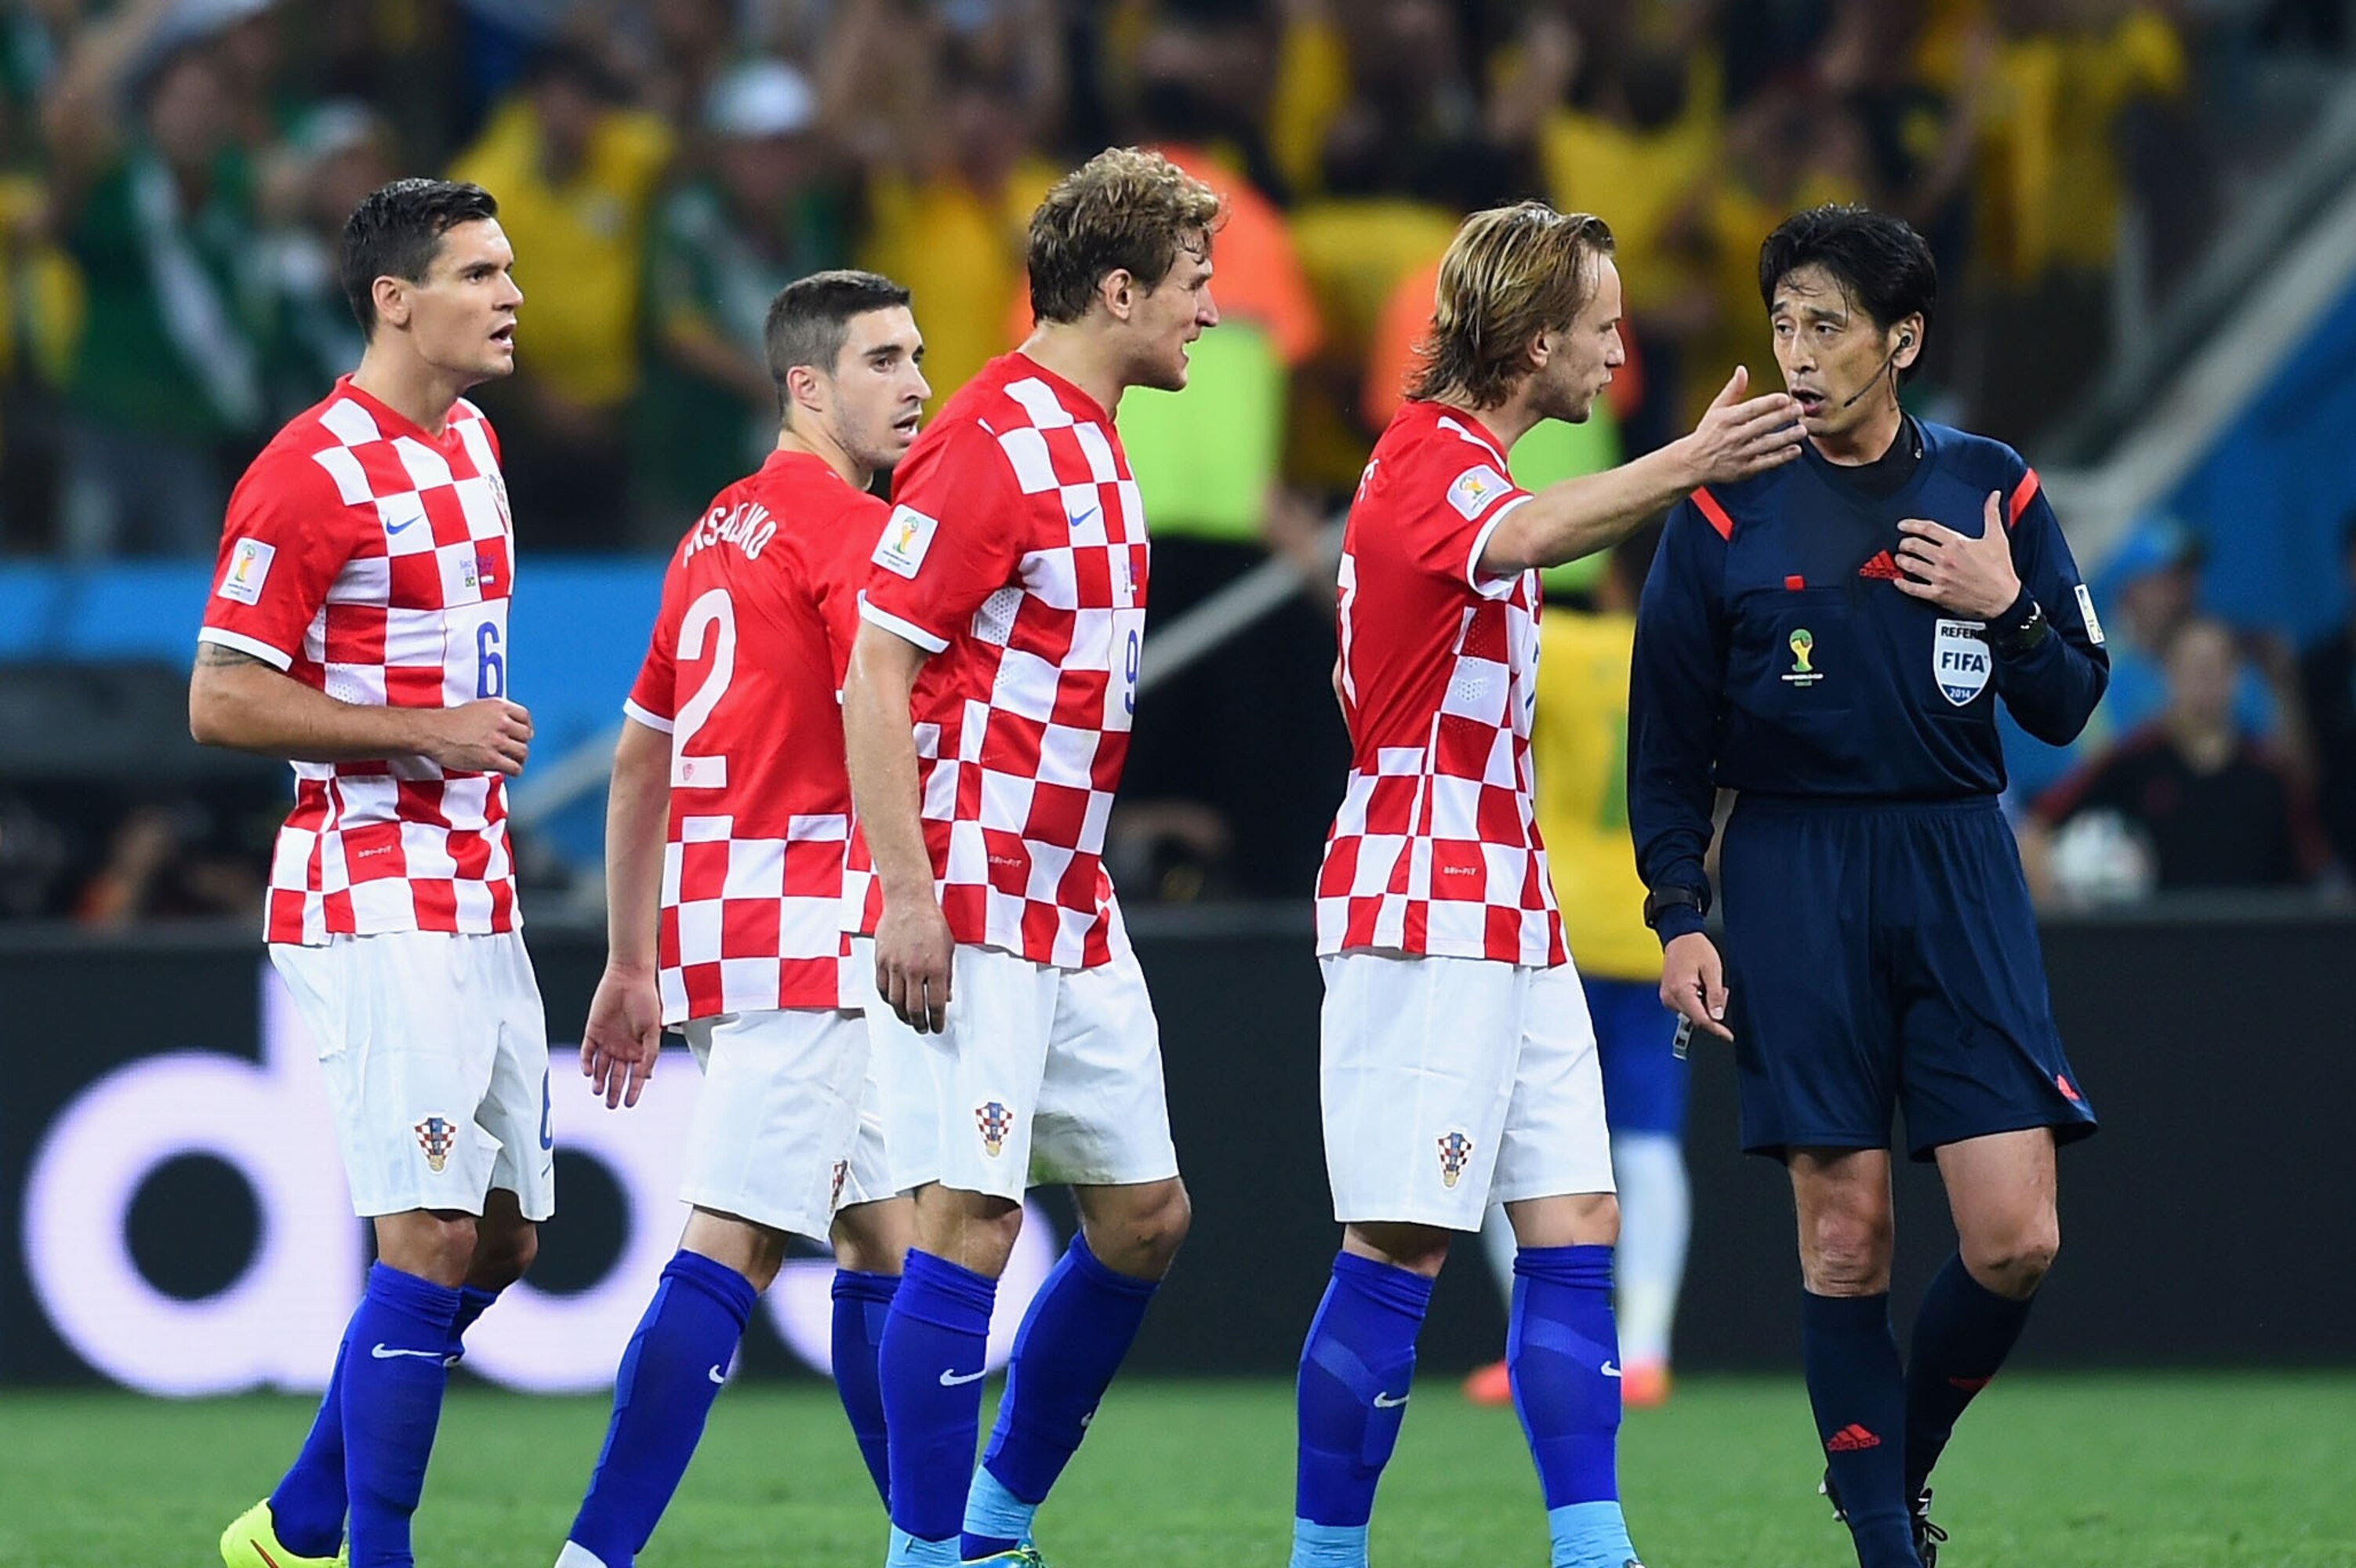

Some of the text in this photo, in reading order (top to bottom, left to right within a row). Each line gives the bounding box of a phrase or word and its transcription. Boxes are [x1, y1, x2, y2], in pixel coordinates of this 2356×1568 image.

[477, 622, 503, 699] 6
[670, 588, 736, 788] 2
[1124, 629, 1138, 715] 9
[1941, 652, 1985, 673] FIFA
[1949, 688, 1971, 699] 2014
